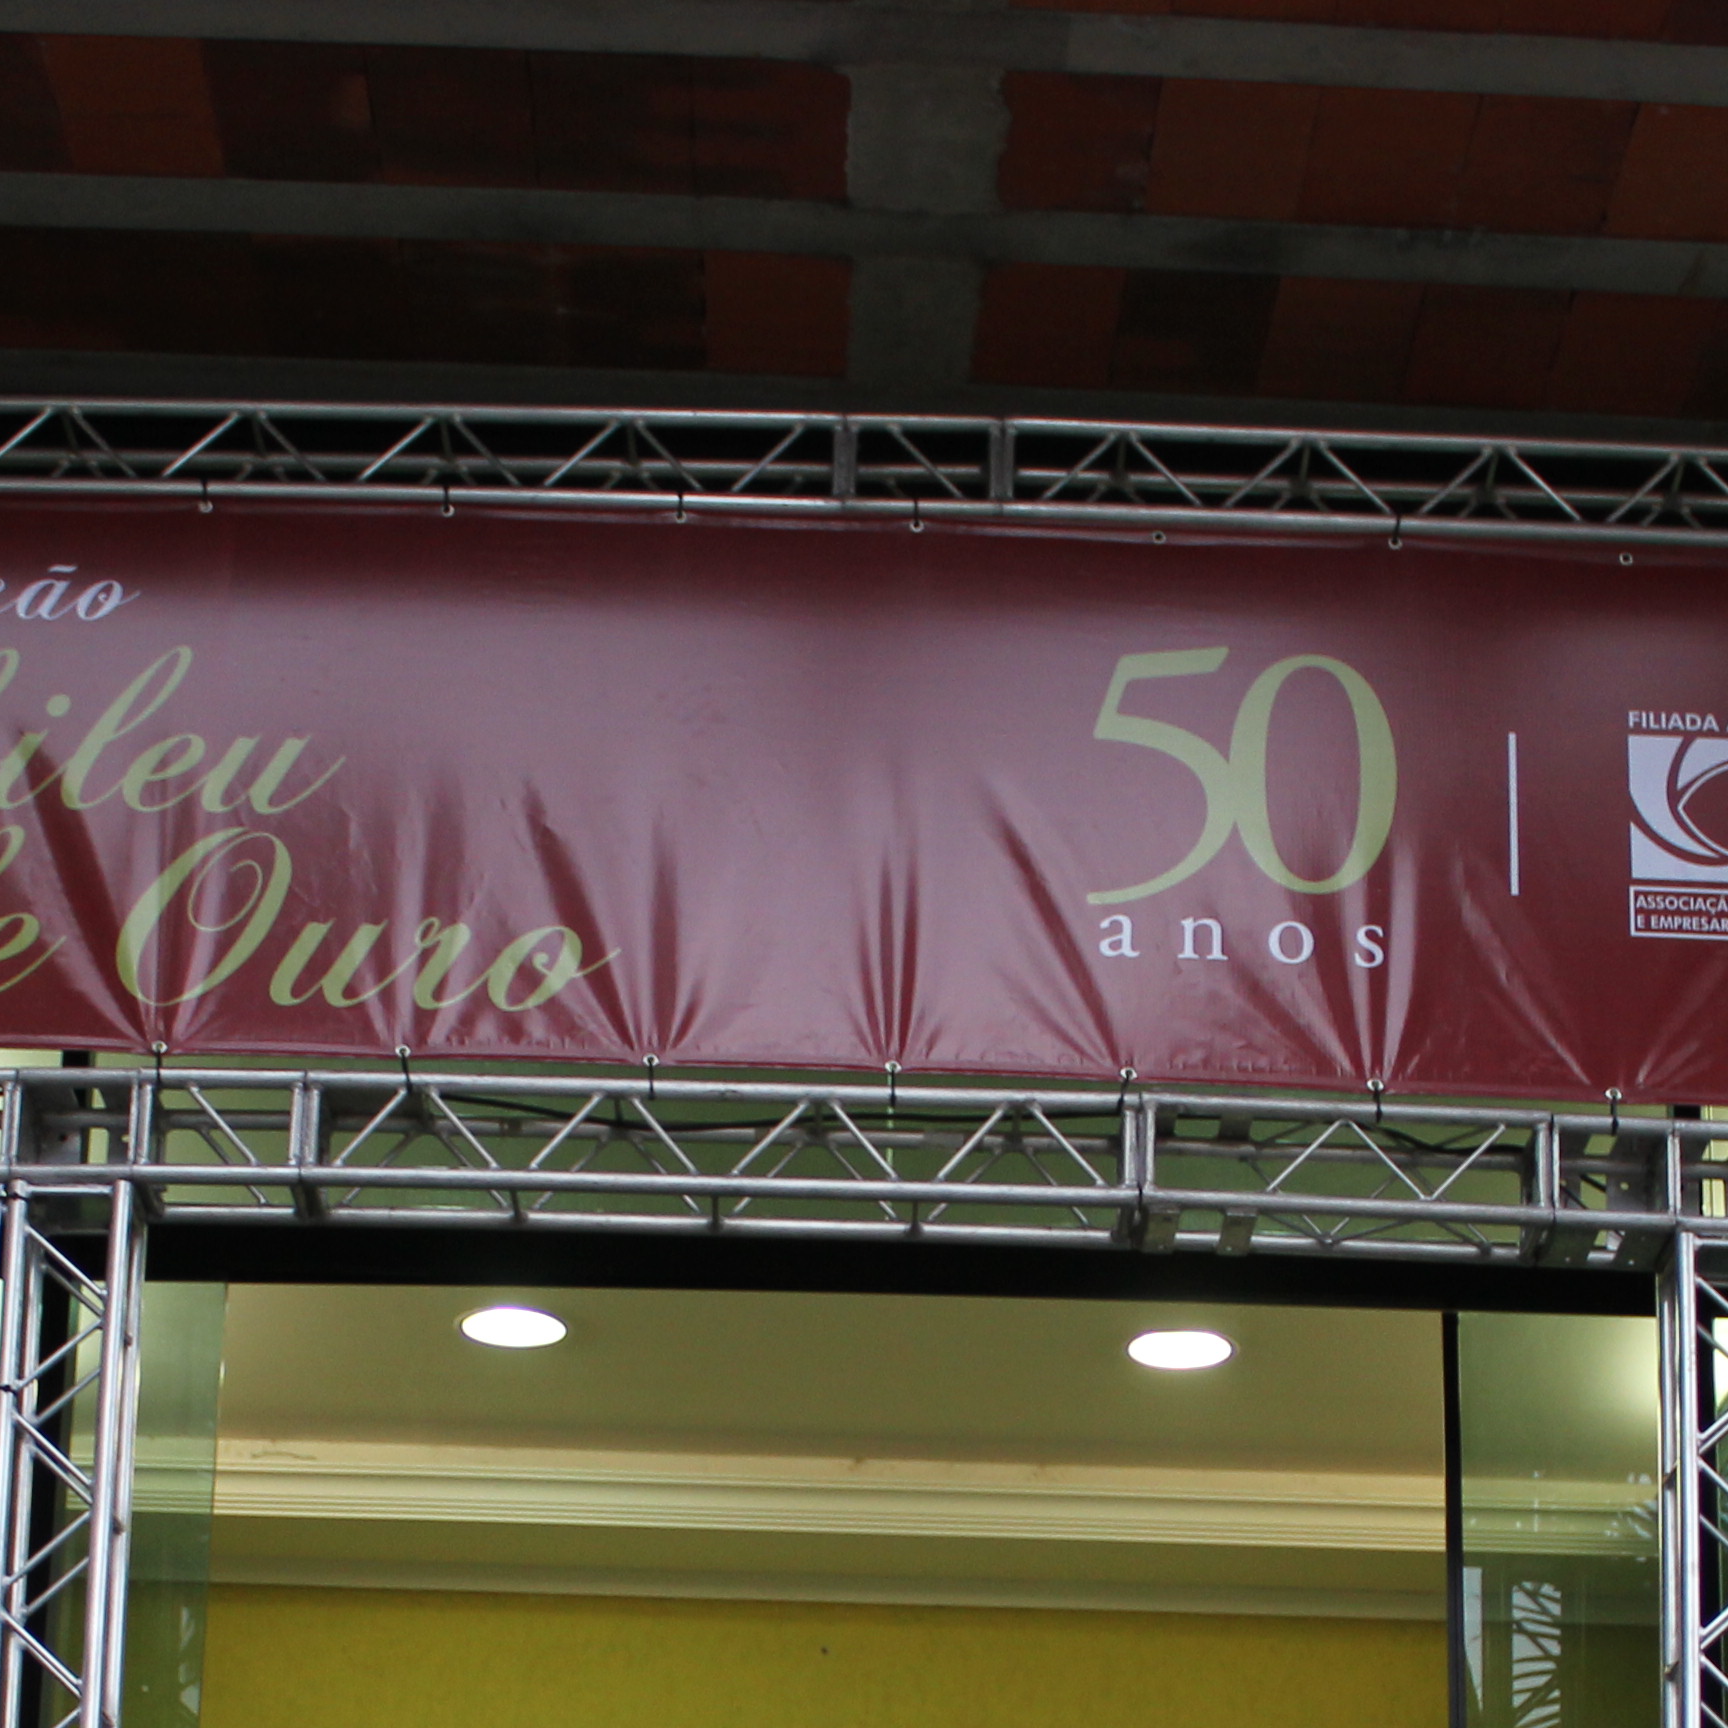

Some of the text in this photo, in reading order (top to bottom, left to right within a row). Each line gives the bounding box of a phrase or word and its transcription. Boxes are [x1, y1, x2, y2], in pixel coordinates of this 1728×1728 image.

[1628, 710, 1719, 732] FILIADA
[1087, 646, 1397, 905] 50
[116, 827, 620, 1013] Ouro
[1099, 907, 1386, 969] anos
[1636, 914, 1645, 930] E
